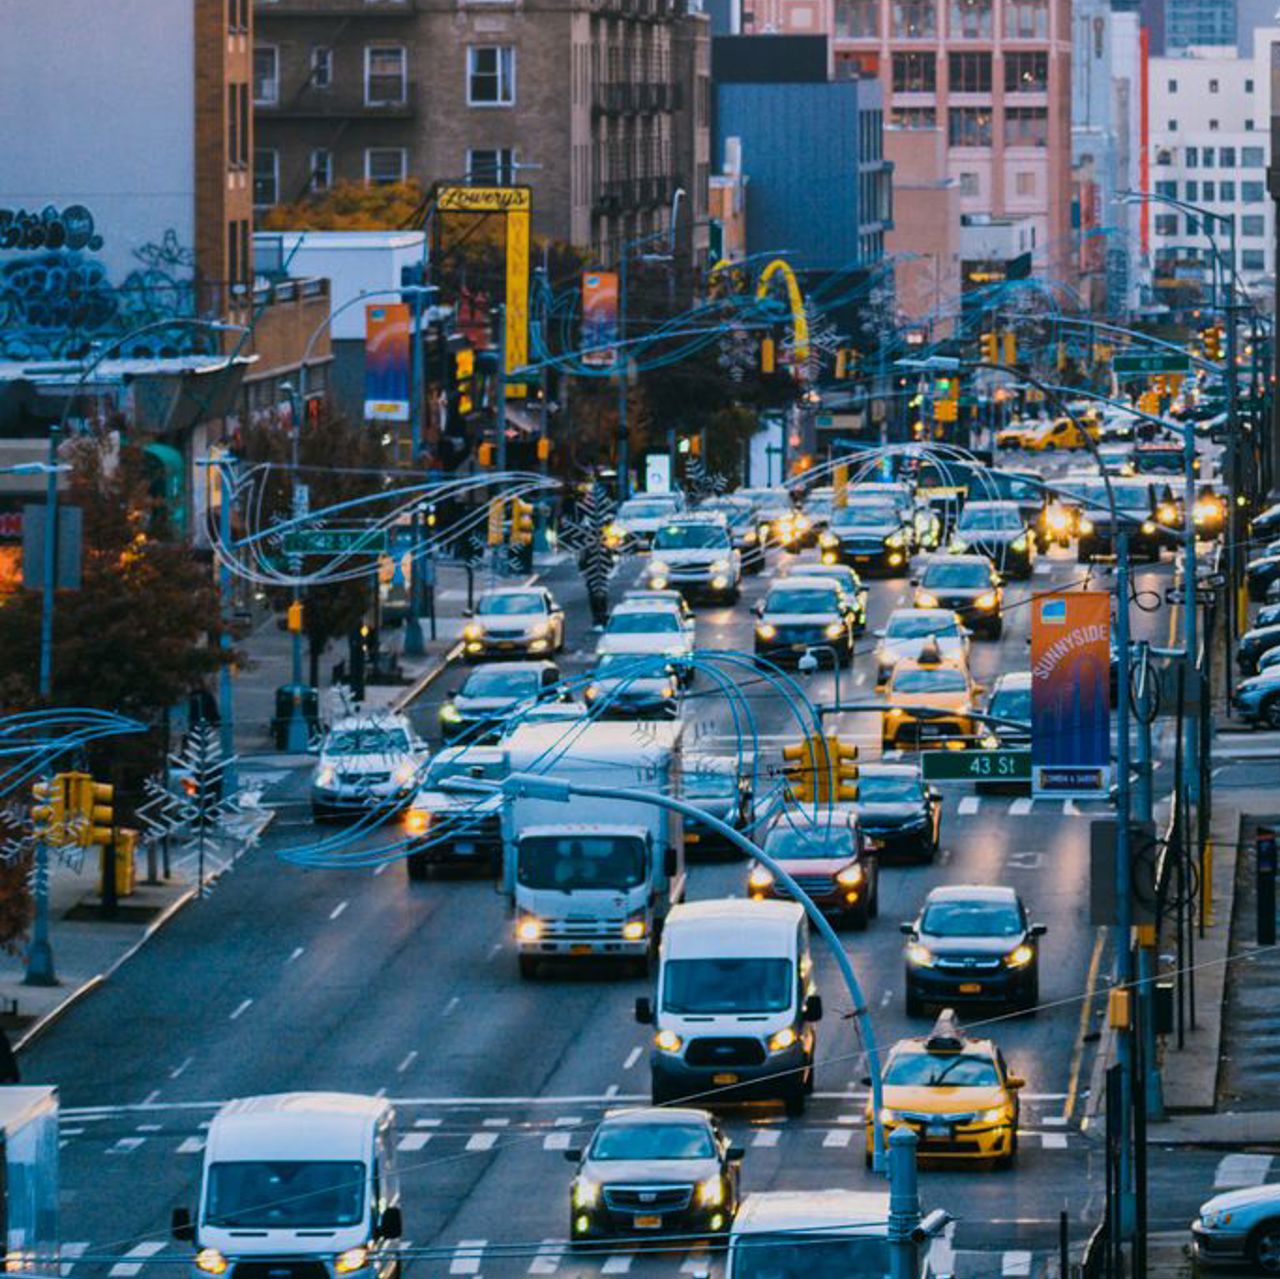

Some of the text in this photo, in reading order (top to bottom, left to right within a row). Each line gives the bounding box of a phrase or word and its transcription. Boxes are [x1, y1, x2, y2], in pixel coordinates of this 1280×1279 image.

[1033, 624, 1109, 680] SUNNYSIDE
[970, 757, 1015, 774] 43 St
